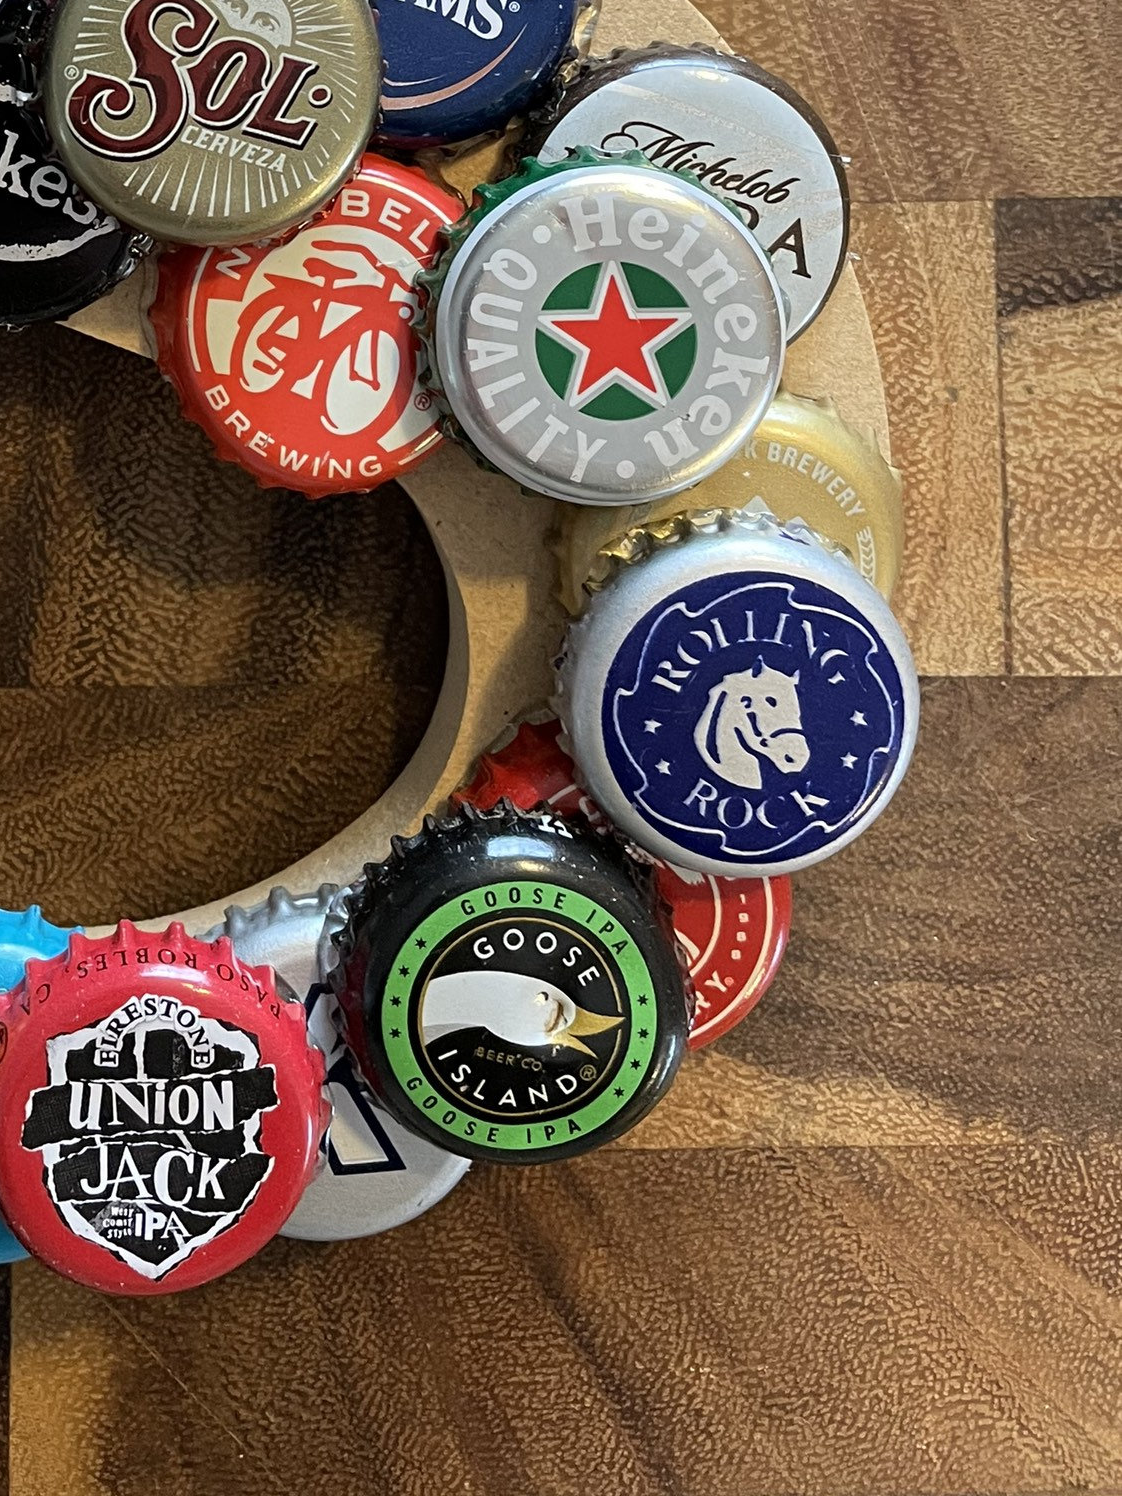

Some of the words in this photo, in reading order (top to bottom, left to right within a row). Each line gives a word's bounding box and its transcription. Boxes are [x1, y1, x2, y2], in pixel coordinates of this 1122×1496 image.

[179, 125, 287, 174] CERVEZA
[600, 121, 801, 205] Michelob
[559, 193, 770, 468] Heineken
[466, 248, 609, 483] QUALITY
[204, 384, 383, 480] BREWING
[766, 441, 866, 518] BREWERY
[650, 609, 850, 692] ROLLING
[683, 778, 830, 830] ROCK
[460, 886, 567, 917] GOOSE
[585, 908, 629, 955] IPA
[473, 928, 600, 987] GOOSE
[97, 997, 214, 1066] FIRESTONE
[474, 1046, 515, 1066] BEER
[406, 1076, 500, 1144] GOOSE
[526, 1118, 582, 1144] IPA
[438, 1049, 578, 1107] ISLAND
[80, 1141, 230, 1207] JACK
[134, 1210, 193, 1241] IPA
